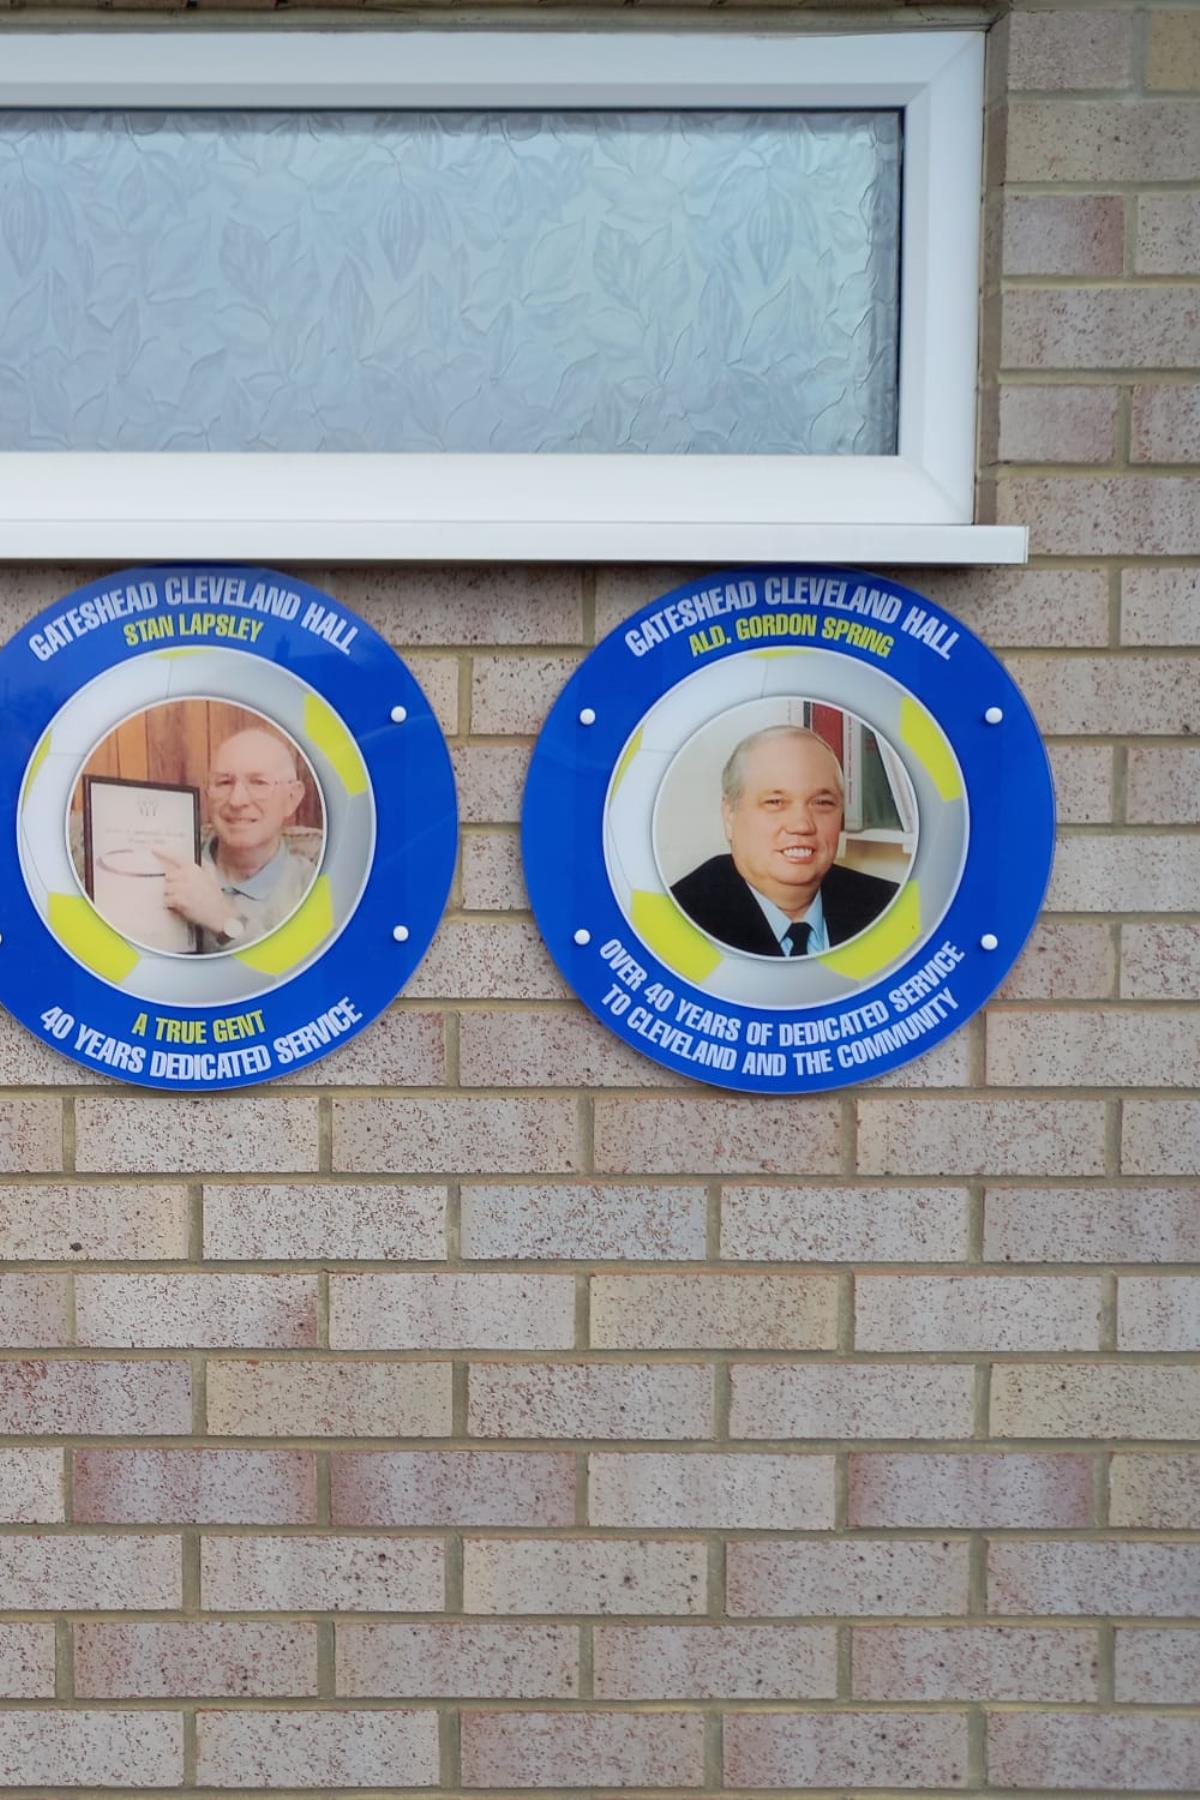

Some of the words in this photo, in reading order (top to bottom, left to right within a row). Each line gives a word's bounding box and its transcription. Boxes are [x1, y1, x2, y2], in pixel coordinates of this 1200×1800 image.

[28, 582, 158, 661] GATESHEAD
[165, 577, 301, 621] CLEVELAND
[303, 602, 359, 655] HALL
[124, 615, 175, 646] STAN
[178, 612, 264, 643] LAPSLEY
[624, 581, 757, 657] GATESHEAD
[764, 577, 903, 624] CLEVELAND
[903, 606, 960, 660] HALL
[688, 625, 732, 657] ALD.
[735, 613, 818, 641] GORDON
[822, 617, 895, 658] SPRING
[131, 1012, 148, 1037] A
[155, 1017, 207, 1045] TRUE
[212, 1009, 265, 1043] GENT
[599, 938, 648, 992] OVER
[643, 982, 675, 1012] 40
[675, 998, 742, 1042] YEARS
[746, 1021, 774, 1046] OF
[779, 1000, 890, 1047] DEDICATED
[891, 940, 965, 1012] SERVICE
[601, 983, 631, 1016] TO
[626, 1006, 738, 1071] CLEVELAND
[741, 1051, 787, 1077] AND
[792, 1048, 834, 1076] THE
[838, 989, 959, 1068] COMMUNITY
[40, 1006, 75, 1040] 40
[76, 1025, 146, 1073] YEARS
[151, 1046, 272, 1081] DEDICATED
[277, 997, 363, 1064] SERVICE
